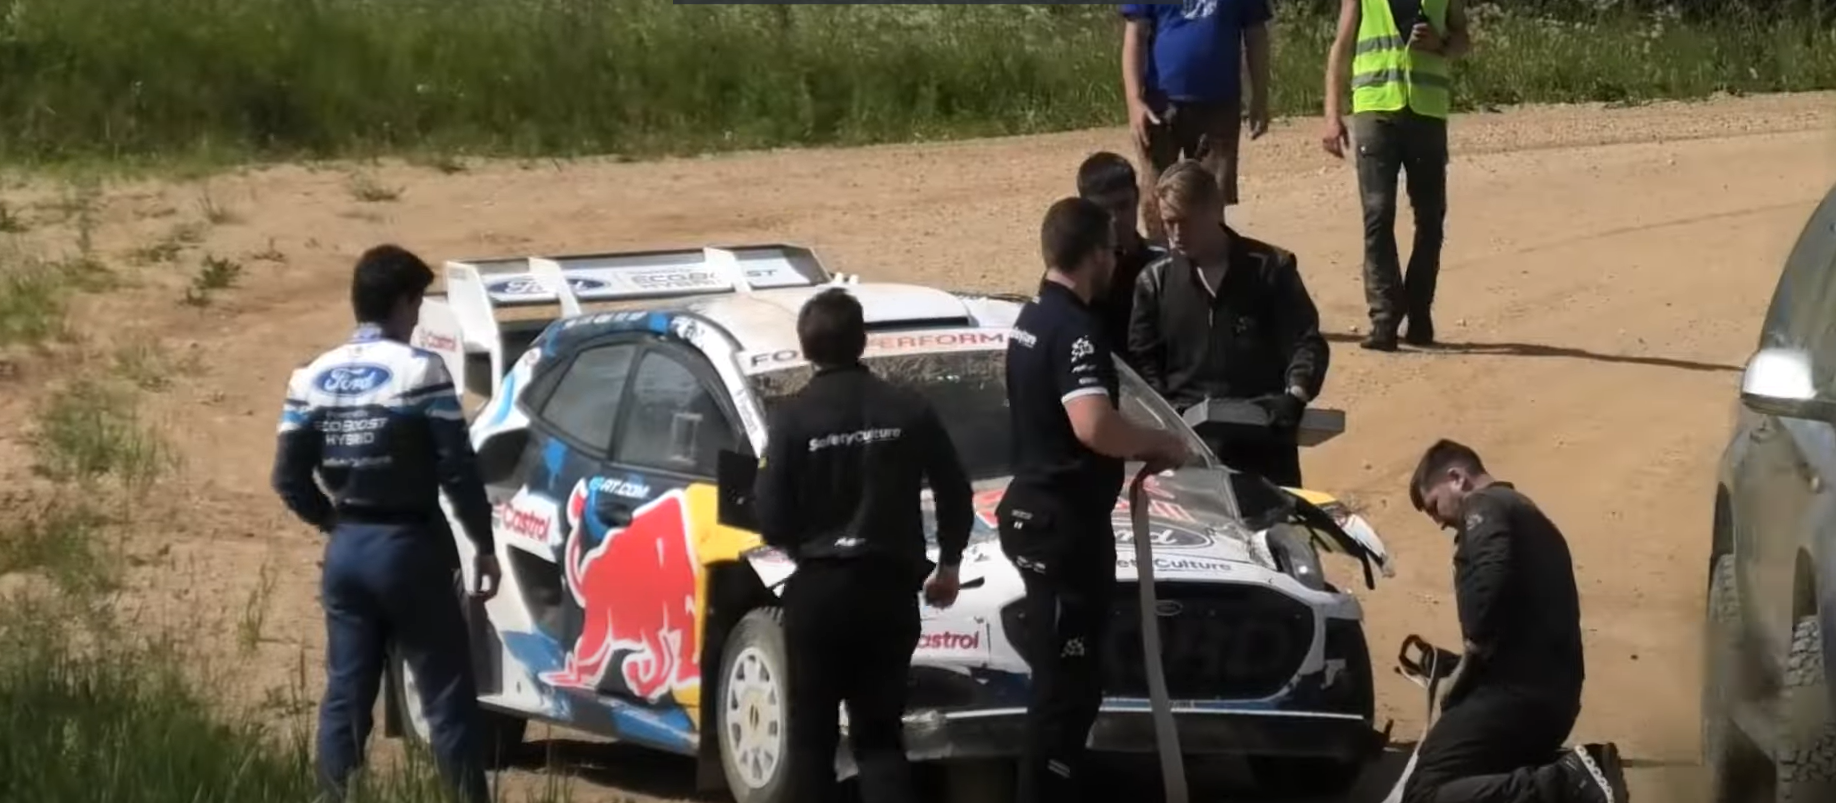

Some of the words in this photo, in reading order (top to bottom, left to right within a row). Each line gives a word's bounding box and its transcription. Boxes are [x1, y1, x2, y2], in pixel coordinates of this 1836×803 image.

[751, 350, 798, 367] FO
[324, 366, 378, 392] Ford
[325, 433, 374, 446] HYBRID
[809, 428, 901, 451] SafetyCulture
[502, 502, 551, 541] Castrol
[918, 631, 979, 650] astrol
